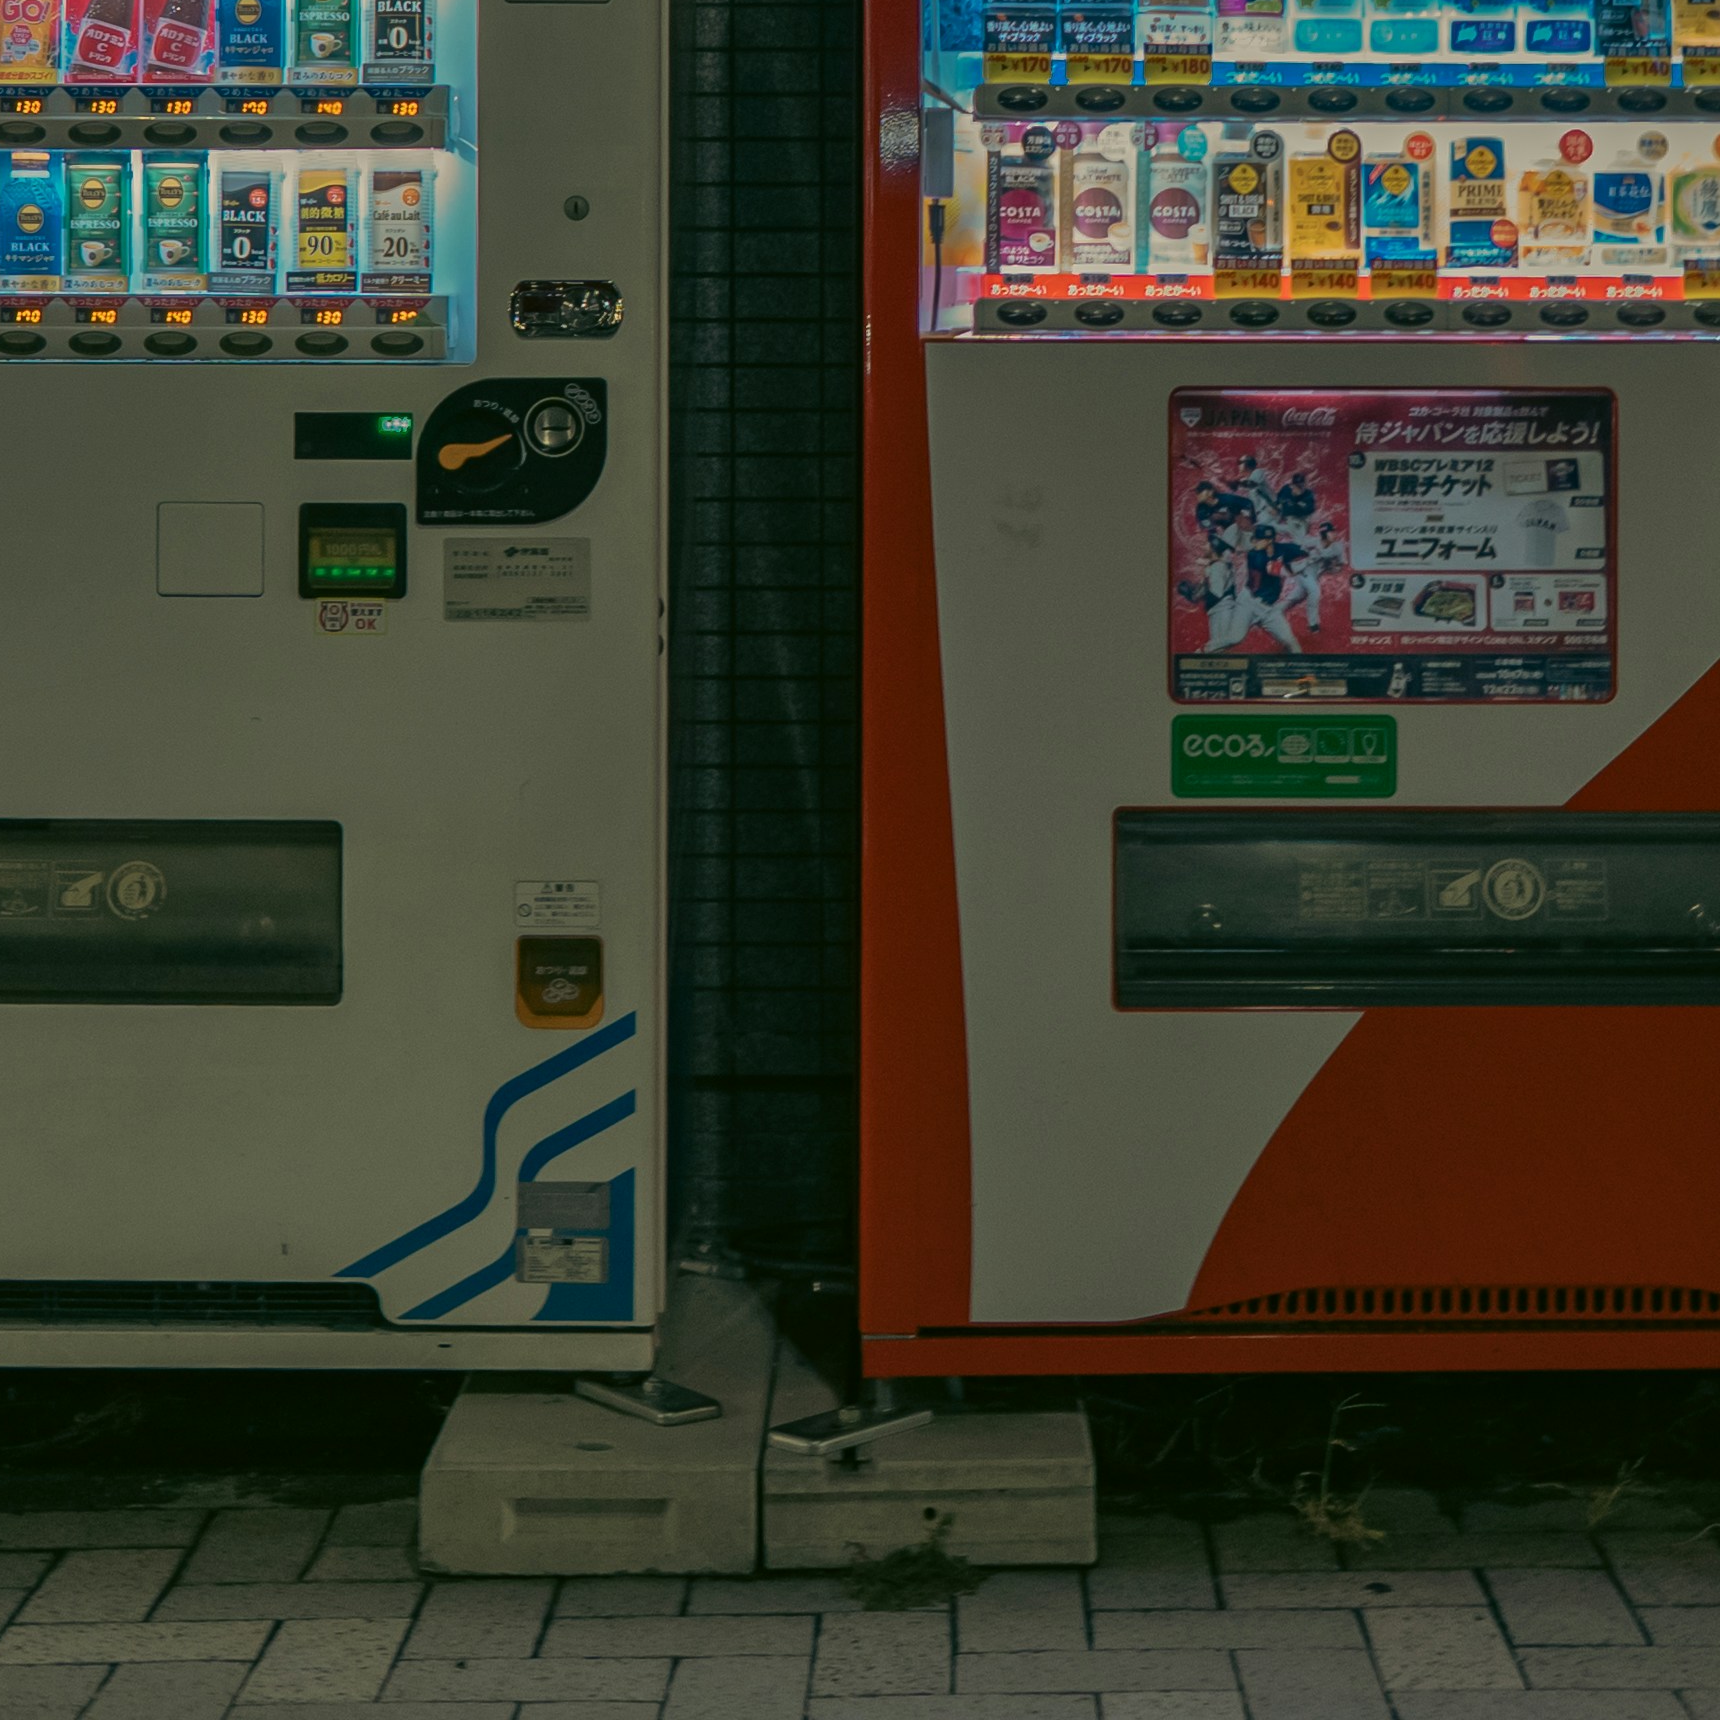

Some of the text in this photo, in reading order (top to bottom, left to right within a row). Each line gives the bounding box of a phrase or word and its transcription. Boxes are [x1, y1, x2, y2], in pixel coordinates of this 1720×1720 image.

[377, 0, 422, 13] BLACK
[299, 11, 350, 22] ESPRESSO
[84, 29, 126, 47] オロナミン
[158, 29, 201, 47] オロナミン
[389, 26, 408, 49] 0
[96, 41, 107, 52] C
[170, 41, 181, 52] C
[225, 45, 274, 55] キリマンジャロ
[88, 51, 112, 63] ドリンク
[162, 51, 186, 63] ドリンク
[1011, 56, 1049, 73] ¥170
[1094, 56, 1132, 73] ¥170
[1171, 59, 1210, 74] ¥180
[220, 71, 275, 81] 華やかな香り
[15, 100, 41, 114] 130
[241, 101, 268, 115] 170
[317, 101, 343, 115] 140
[1457, 184, 1503, 198] PRIME
[222, 209, 266, 222] BLACK
[300, 206, 345, 219] 劇的微糖
[373, 209, 421, 221] Café au Lait
[999, 206, 1041, 218] COSTA
[1075, 206, 1121, 218] COSTA
[1151, 206, 1196, 218] COSTA
[70, 219, 120, 229] ESPRESSO
[147, 218, 198, 228] ESPRESSO
[232, 235, 251, 259] 0
[307, 235, 332, 255] 90
[383, 237, 408, 258] 20
[1007, 255, 1045, 264] 香りとコク
[390, 275, 429, 285] クリーミー
[1243, 273, 1279, 289] ¥140
[1319, 273, 1356, 289] ¥140
[1398, 273, 1435, 289] ¥140
[91, 310, 117, 323] 140
[166, 310, 192, 324] 140
[1408, 406, 1472, 417] コカ・コーラ社
[1354, 421, 1601, 446] 侍ジャパンを応援しよう!
[1374, 458, 1495, 473] WBSCプレミア12
[1374, 474, 1493, 497] 観戦チケット
[1375, 536, 1498, 560] ユニフォーム
[1369, 581, 1406, 593] 野球盤
[355, 618, 377, 630] OK
